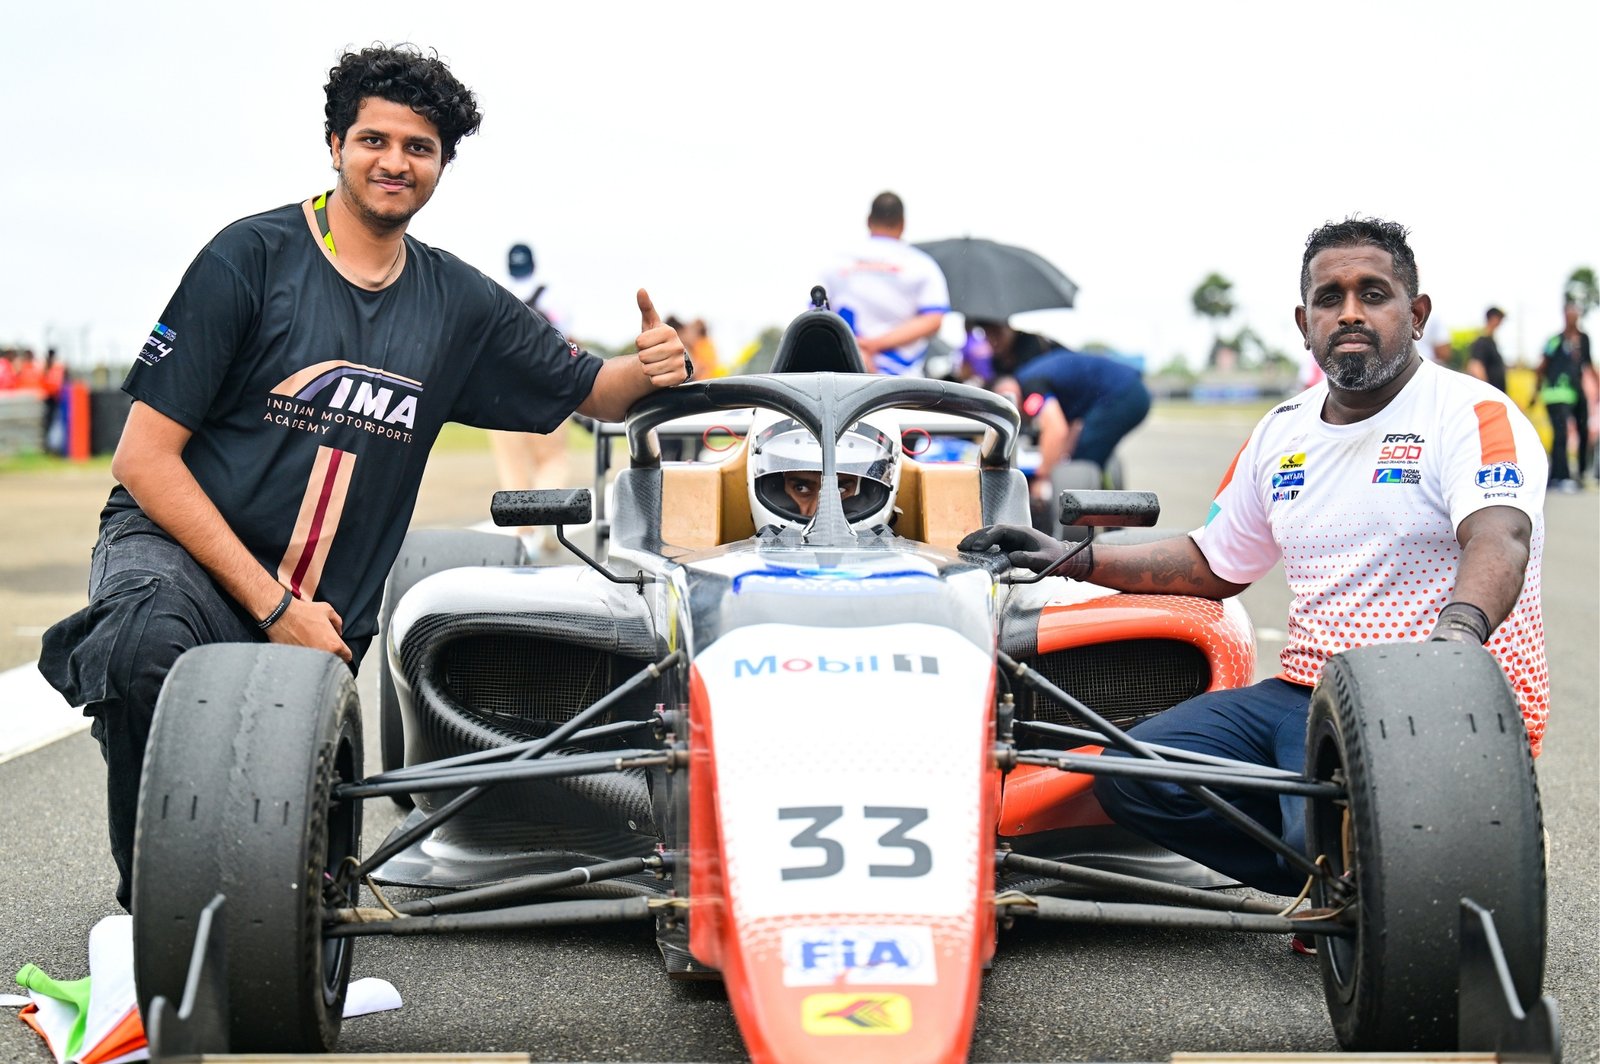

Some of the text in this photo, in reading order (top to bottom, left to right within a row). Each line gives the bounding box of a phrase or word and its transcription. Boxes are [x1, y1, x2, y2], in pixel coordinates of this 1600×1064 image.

[263, 412, 330, 435] ACADEMY
[266, 398, 413, 443] INDIAN MOTORSPORTS
[328, 376, 418, 429] IMA
[734, 655, 879, 678] Mobil
[778, 805, 933, 881] 33
